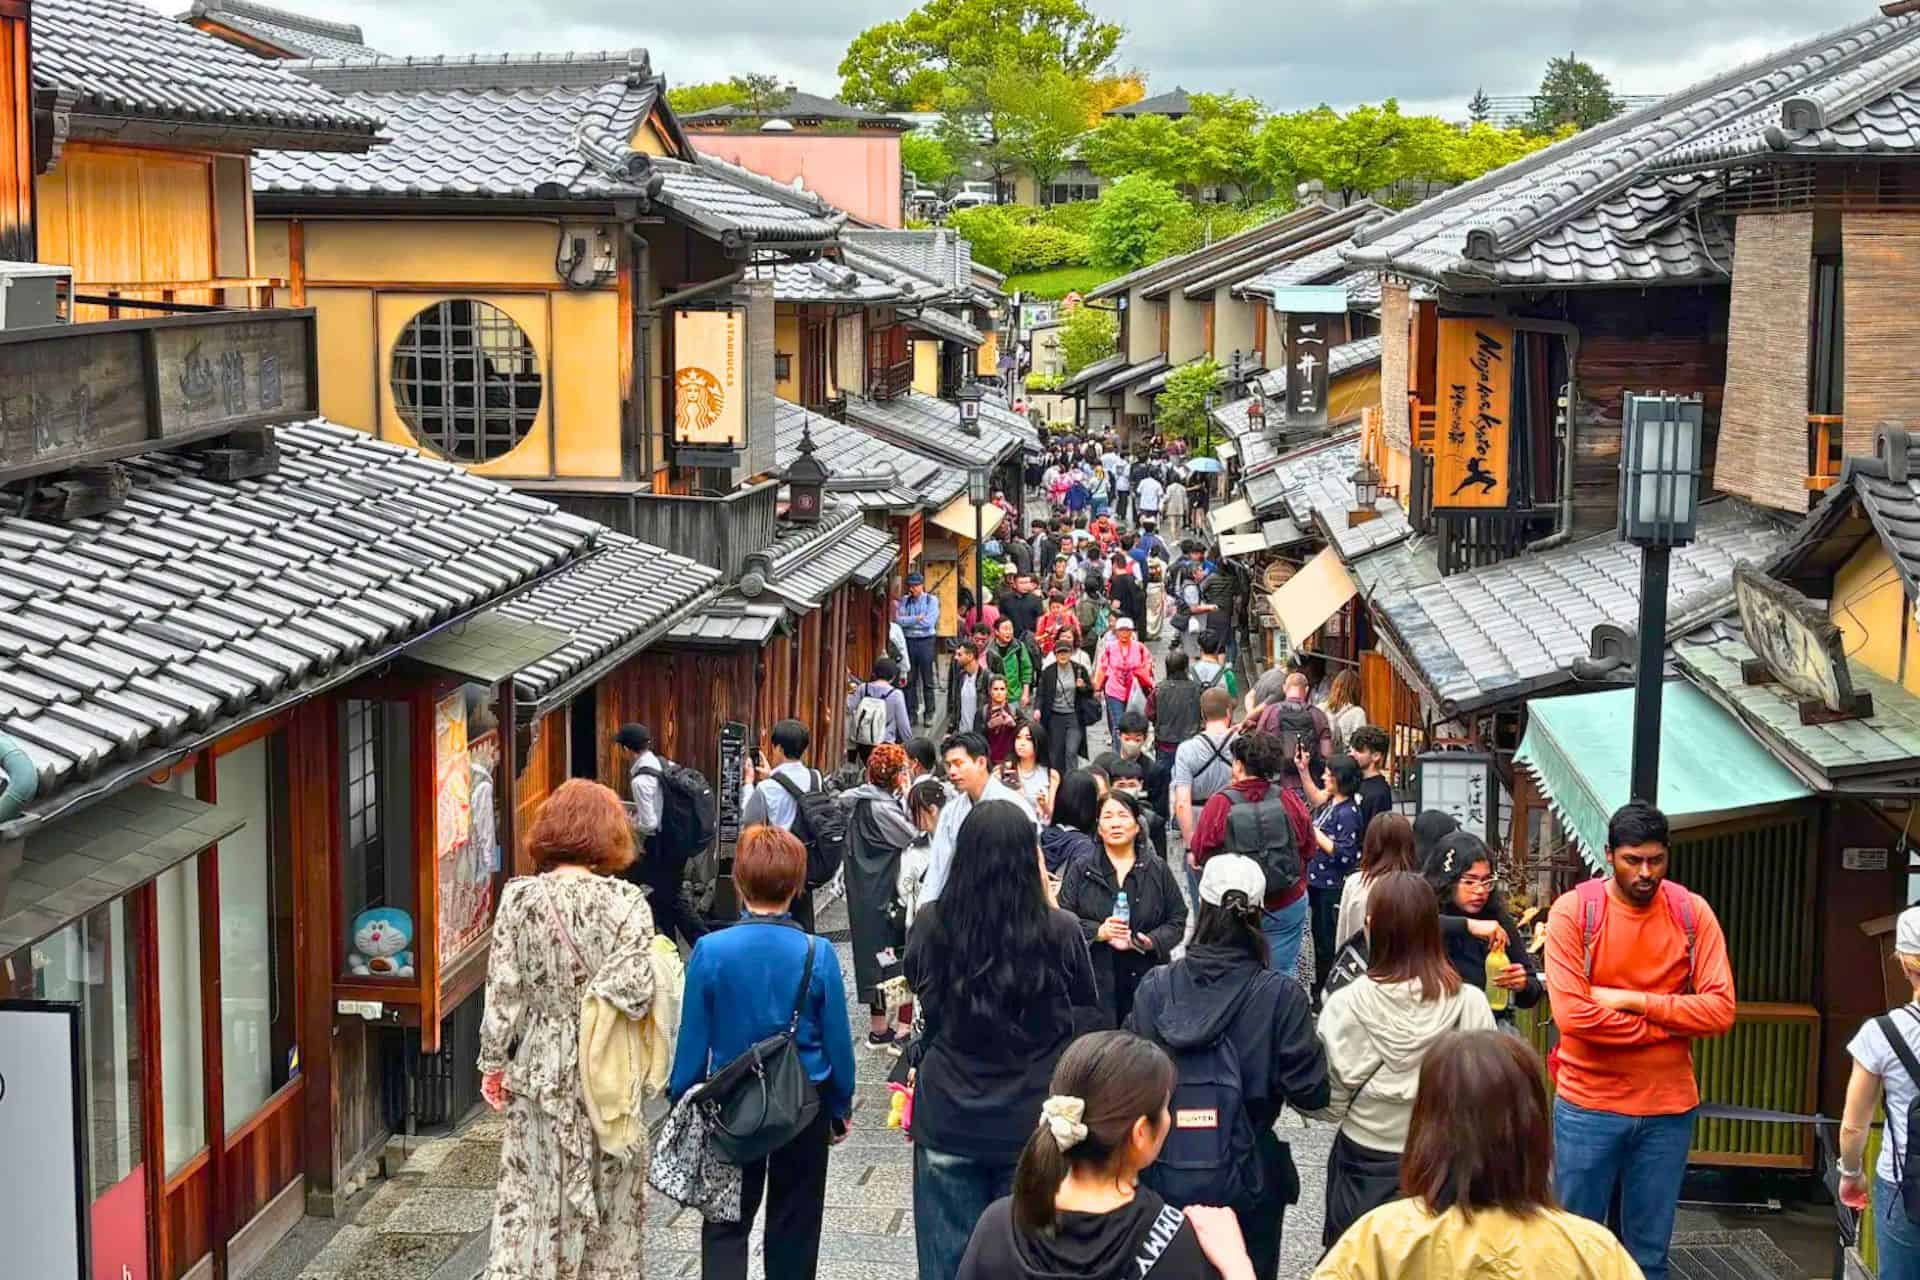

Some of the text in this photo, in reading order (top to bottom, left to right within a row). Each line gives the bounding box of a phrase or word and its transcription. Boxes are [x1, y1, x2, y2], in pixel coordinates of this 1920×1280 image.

[726, 319, 734, 387] STARBUCKS
[1469, 329, 1504, 382] Ninja
[1468, 772, 1484, 824] そば処
